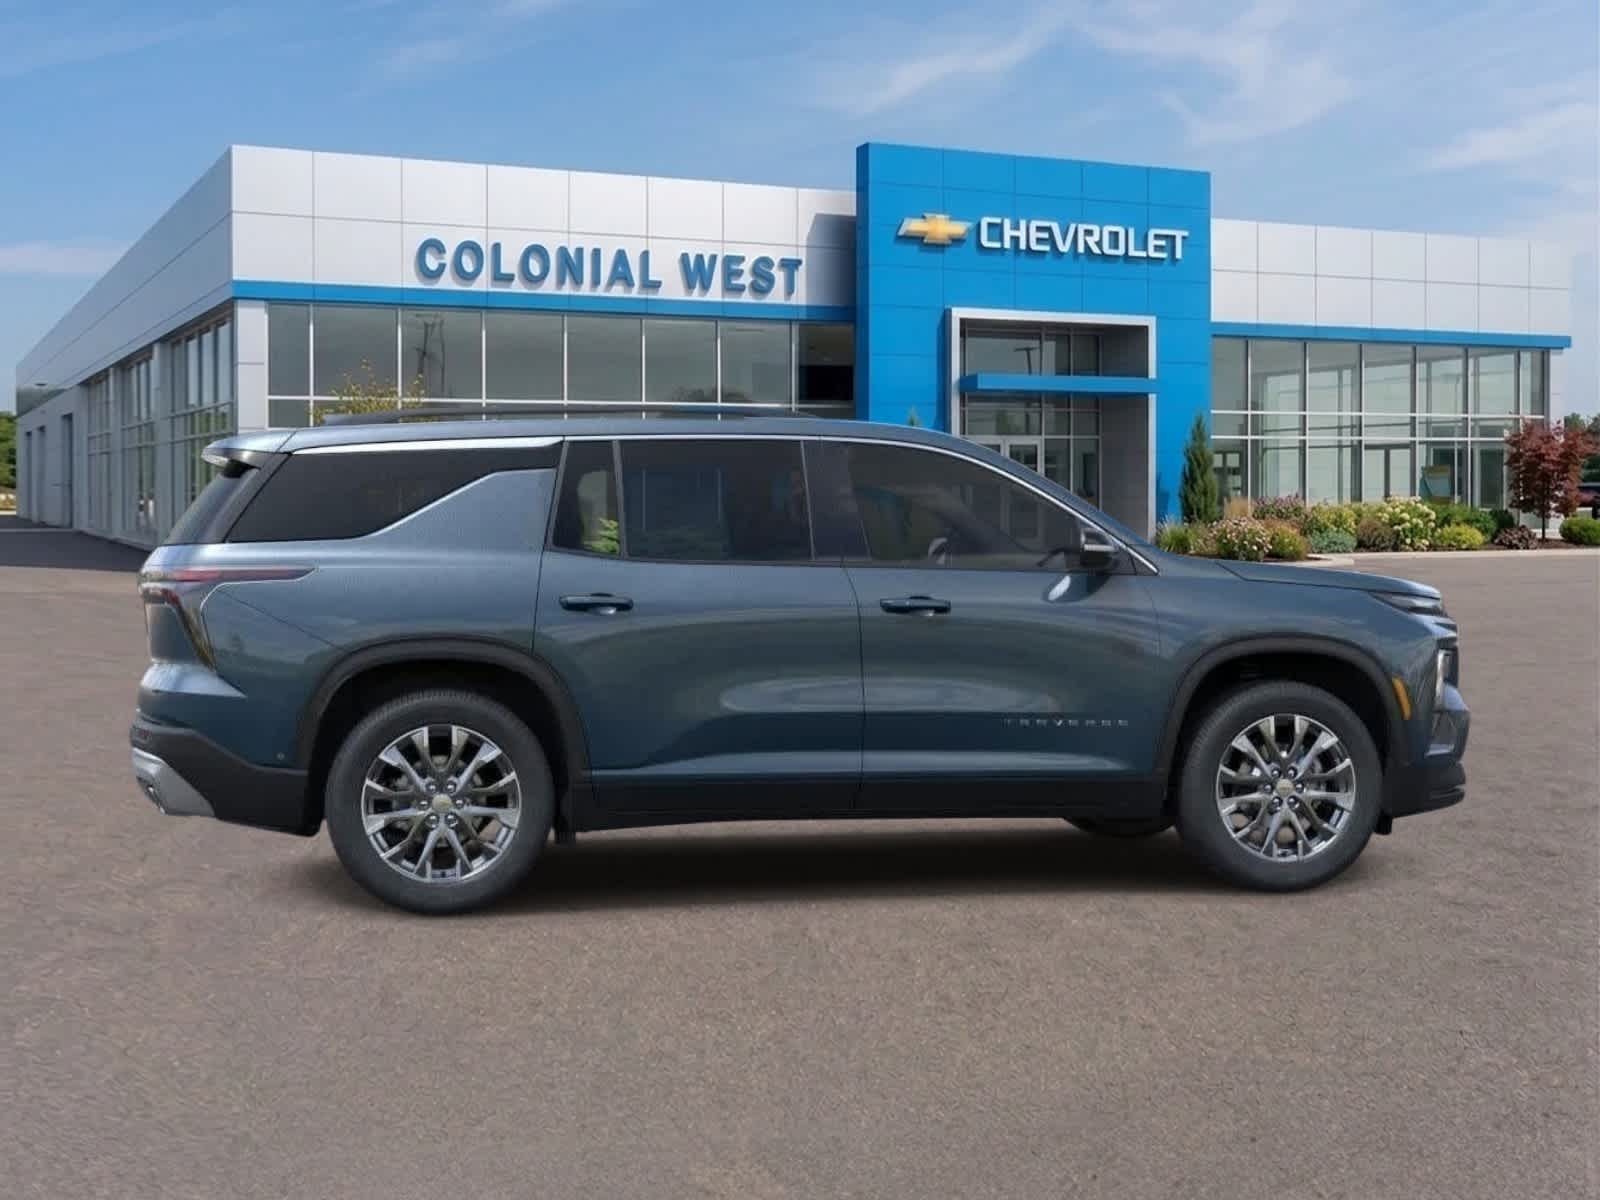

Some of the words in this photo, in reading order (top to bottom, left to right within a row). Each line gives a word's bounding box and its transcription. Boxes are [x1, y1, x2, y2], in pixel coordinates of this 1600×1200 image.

[979, 216, 1189, 260] CHEVROLET
[416, 238, 662, 289] COLONIAL
[679, 251, 803, 296] WEST
